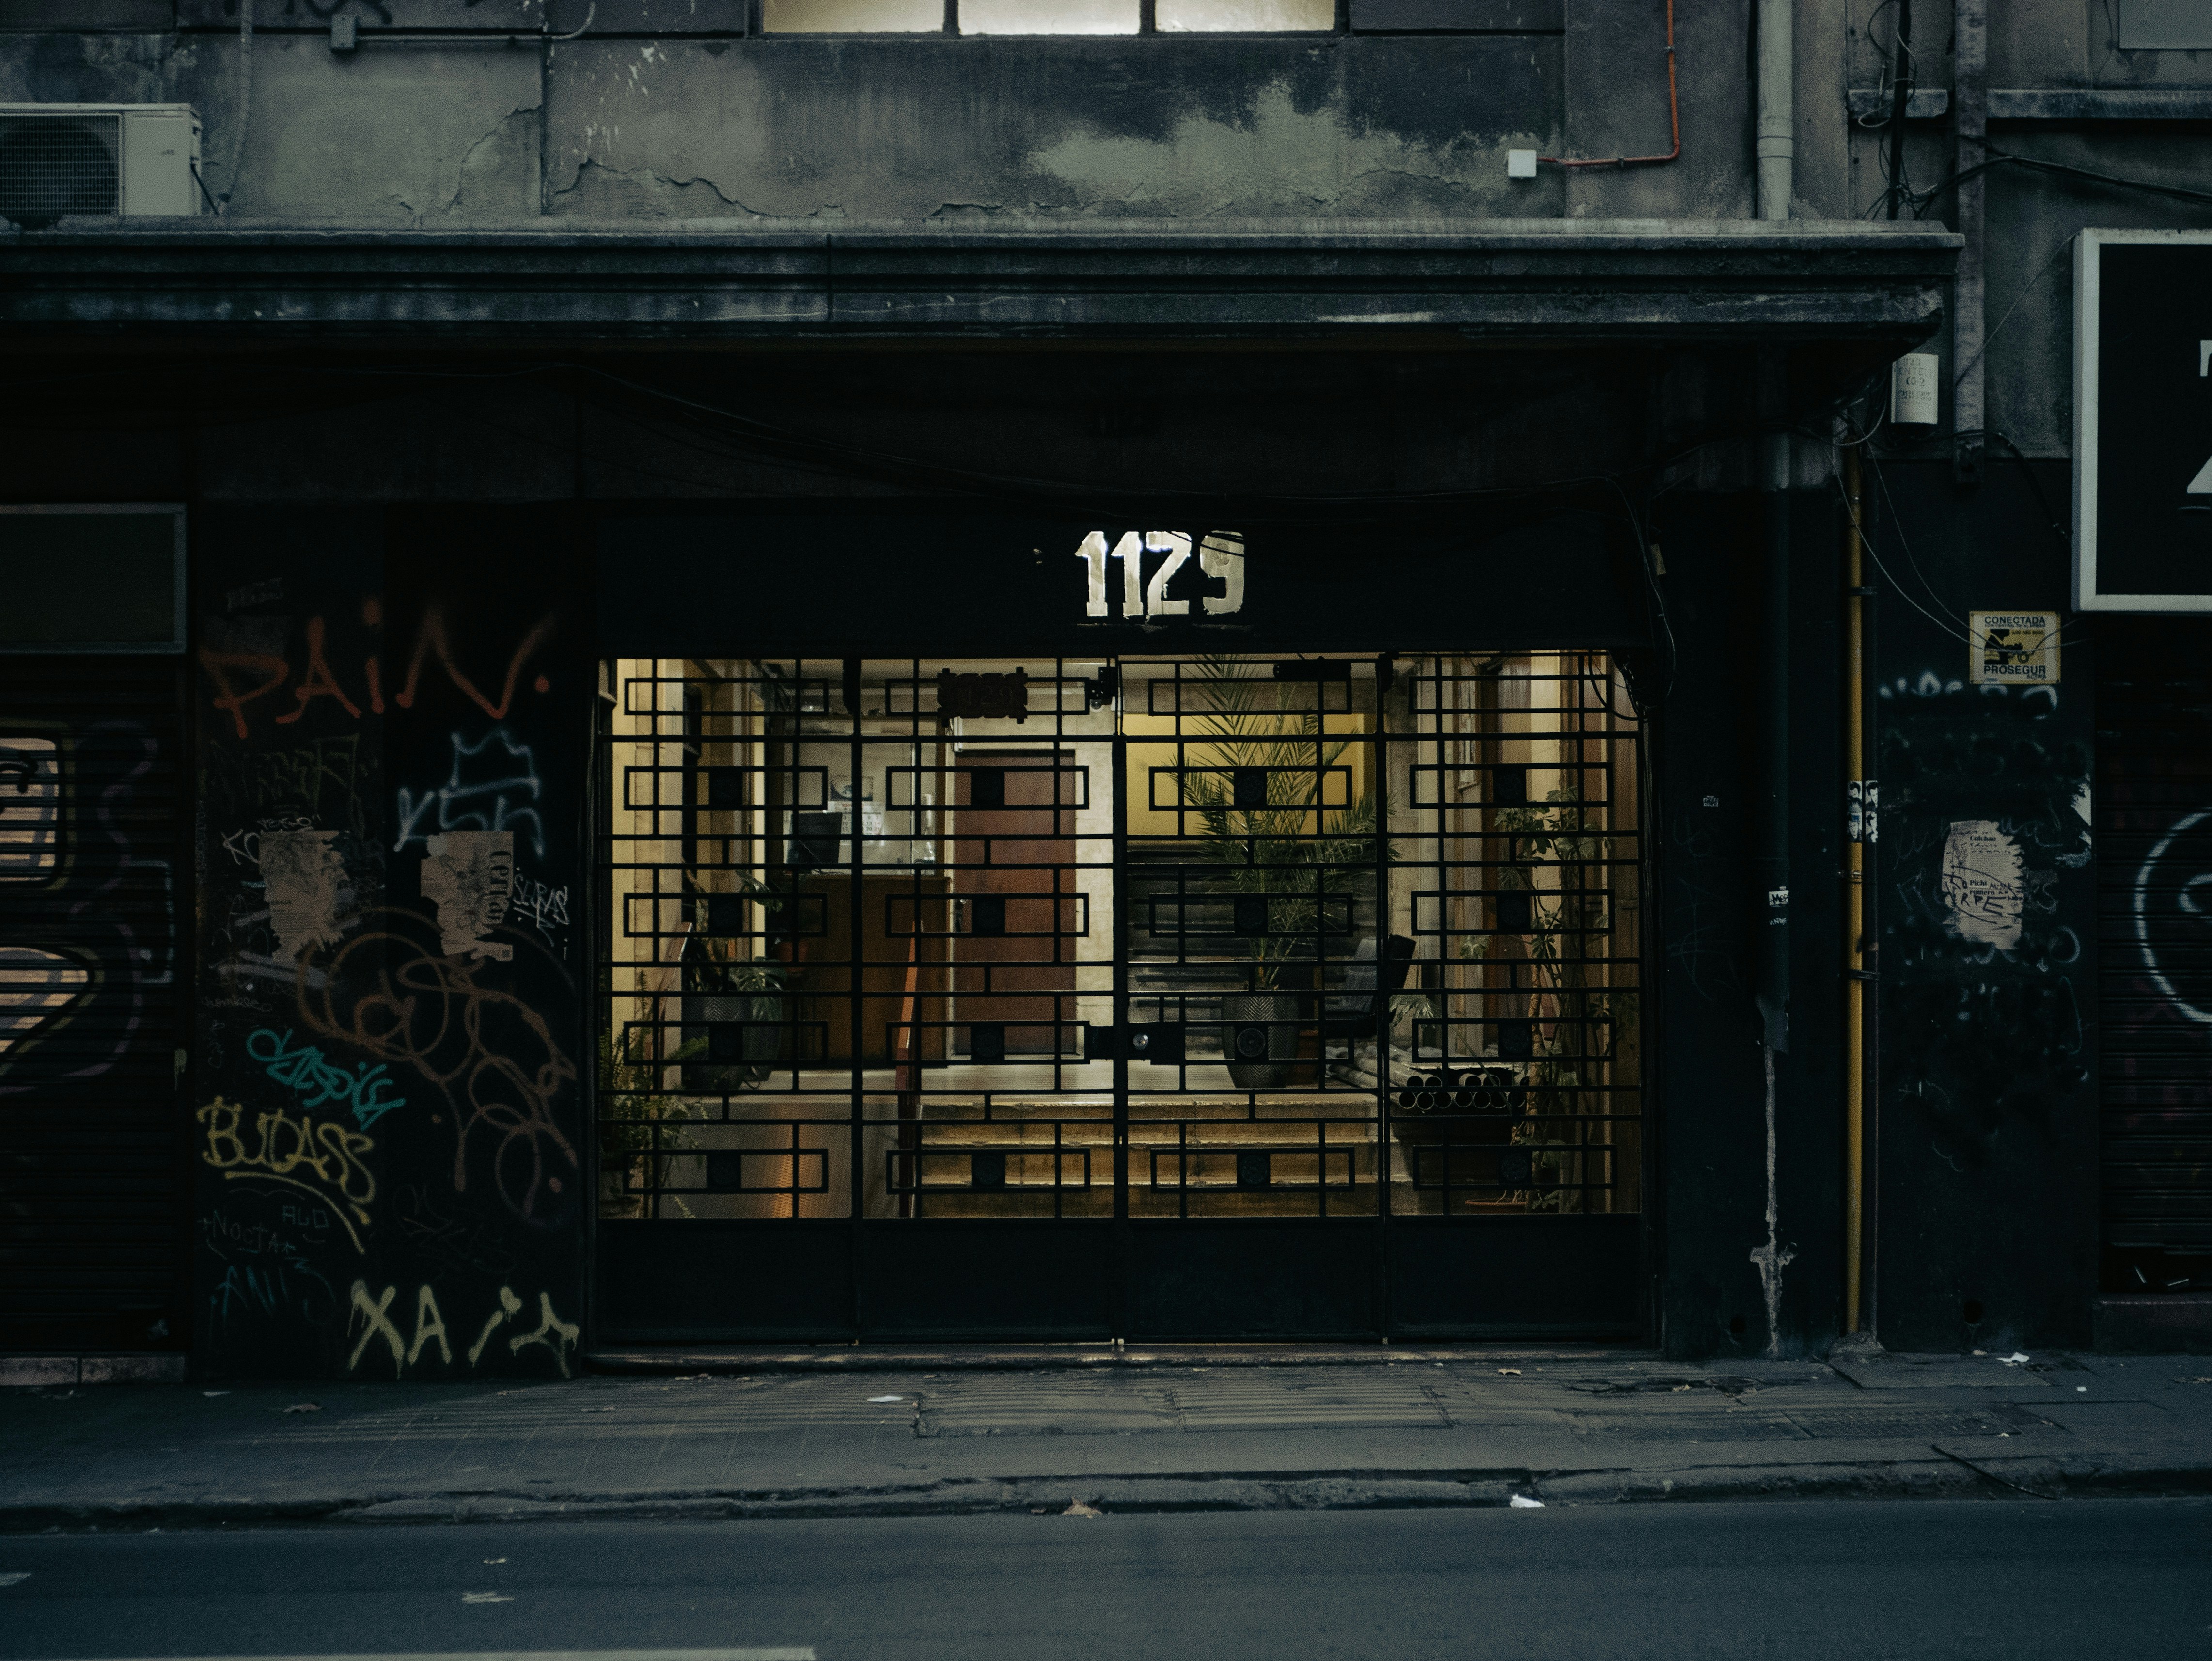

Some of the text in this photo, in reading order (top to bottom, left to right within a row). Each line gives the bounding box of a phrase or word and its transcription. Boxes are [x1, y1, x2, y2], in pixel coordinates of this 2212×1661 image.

[1074, 530, 1245, 618] 1129
[1984, 616, 2045, 624] CONECTADA
[1984, 665, 2046, 675] PROSEGUR
